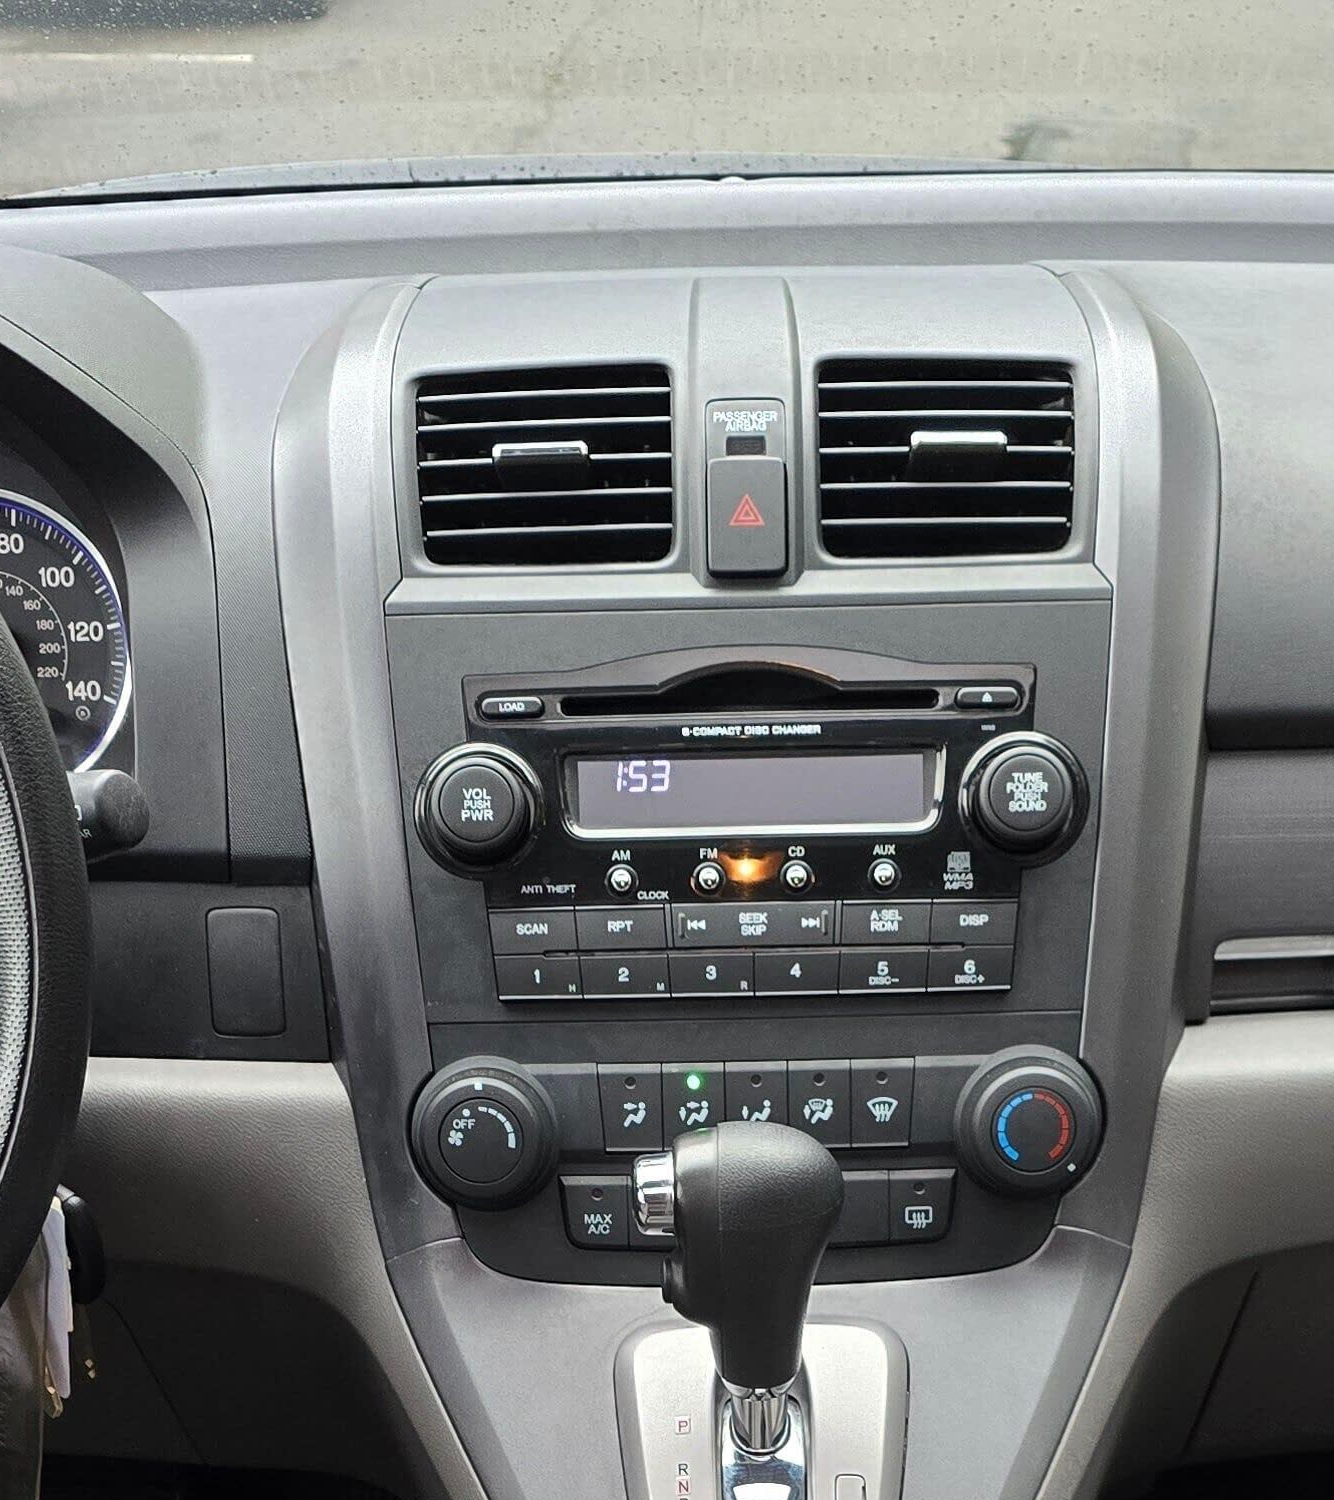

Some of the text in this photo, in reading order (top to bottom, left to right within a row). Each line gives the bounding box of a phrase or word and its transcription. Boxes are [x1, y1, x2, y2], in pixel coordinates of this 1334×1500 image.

[713, 410, 778, 422] PASSENGER
[725, 421, 767, 432] AIRBAG
[38, 566, 75, 588] 100
[5, 584, 24, 597] 140
[23, 600, 41, 611] 160
[36, 619, 55, 631] 180
[67, 620, 104, 643] 120
[38, 643, 61, 655] 200
[36, 666, 60, 678] 220
[66, 680, 102, 702] 140
[498, 702, 525, 712] LOAD
[771, 723, 822, 735] CHANGER
[616, 760, 671, 793] 1:53
[1011, 772, 1044, 783] TUNE
[1005, 781, 1048, 793] FOLDER
[462, 787, 492, 800] VOL
[1013, 792, 1042, 801] PUSH
[463, 800, 491, 809] PUSH
[1008, 800, 1048, 812] SOUND
[460, 809, 494, 821] PWR
[611, 849, 632, 862] AM
[699, 847, 718, 860] FM
[788, 845, 806, 858] CD
[872, 844, 896, 856] AUX
[943, 872, 973, 881] WMA
[520, 883, 577, 894] ANTI THEFT
[944, 880, 973, 890] MP3
[637, 890, 669, 900] CLOCK
[739, 911, 768, 924] SEEK
[959, 914, 989, 926] DISP
[516, 923, 548, 936] SCAN
[607, 920, 634, 932] RPT
[740, 923, 767, 936] SKIP
[870, 920, 899, 932] RDM
[789, 963, 802, 979] 4
[877, 961, 889, 976] 5
[964, 959, 976, 974] 6
[533, 968, 541, 984] 1
[617, 967, 630, 983] 2
[705, 965, 717, 981] 3
[656, 982, 665, 992] M
[740, 980, 749, 991] R
[452, 1118, 476, 1130] OFF
[584, 1213, 613, 1225] MAX
[587, 1224, 611, 1236] A/C
[678, 1420, 689, 1433] P
[678, 1463, 689, 1476] R
[678, 1482, 690, 1495] N
